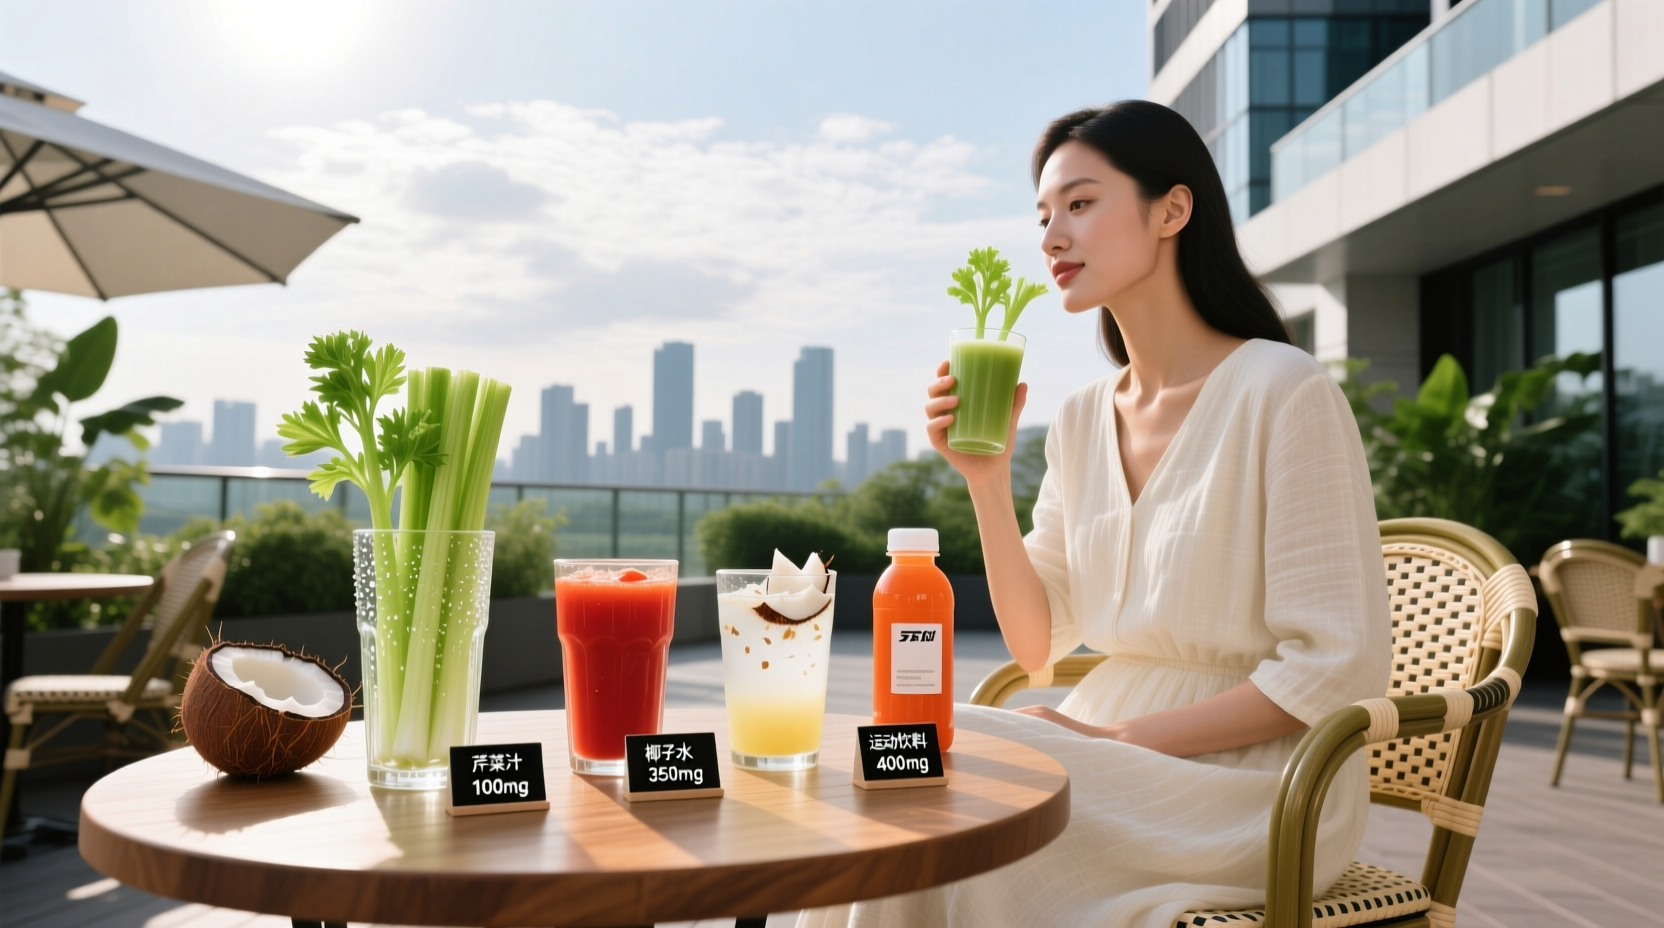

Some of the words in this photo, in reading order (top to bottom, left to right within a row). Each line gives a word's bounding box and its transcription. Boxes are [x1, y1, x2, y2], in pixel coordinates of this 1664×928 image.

[869, 731, 928, 751] 运动饮料
[644, 741, 694, 763] 椰子水
[471, 752, 523, 773] 芹菜汁
[876, 755, 929, 774] 400mg
[648, 766, 703, 785] 350mg
[472, 778, 529, 798] 100mg
